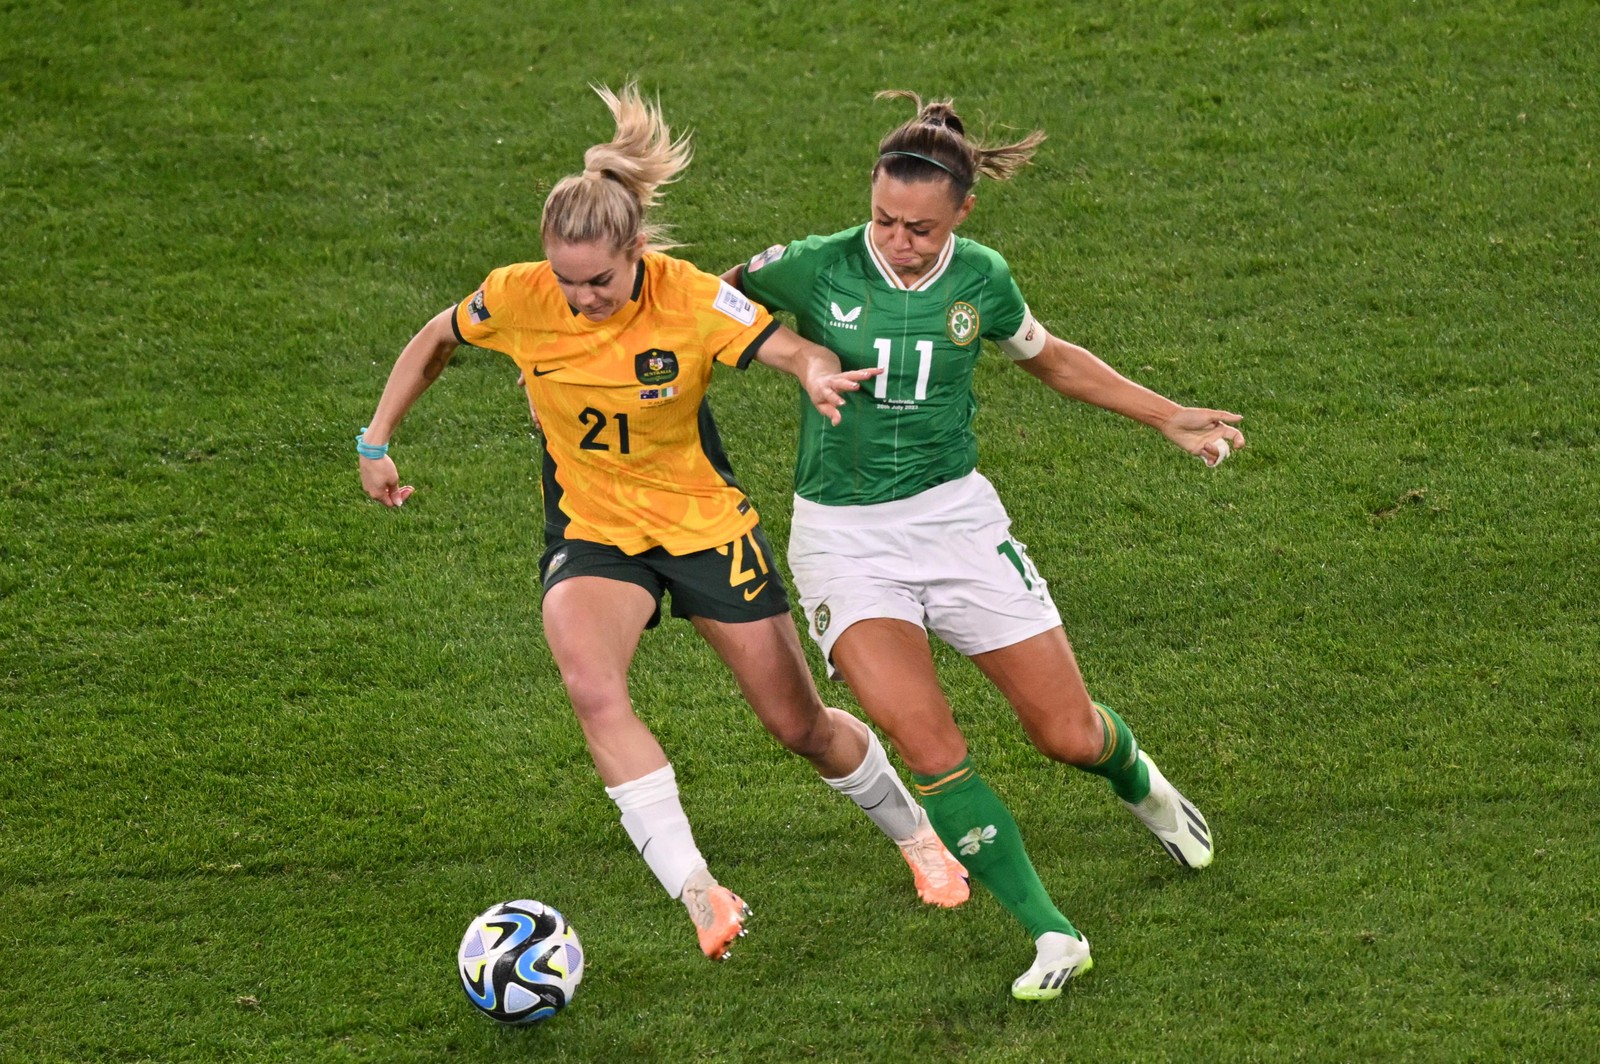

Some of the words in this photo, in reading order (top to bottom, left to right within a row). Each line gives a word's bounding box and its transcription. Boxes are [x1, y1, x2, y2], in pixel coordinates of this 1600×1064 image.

[829, 320, 858, 331] CASTORE
[948, 304, 976, 319] IRELAND
[873, 338, 933, 401] 11
[578, 406, 630, 454] 21
